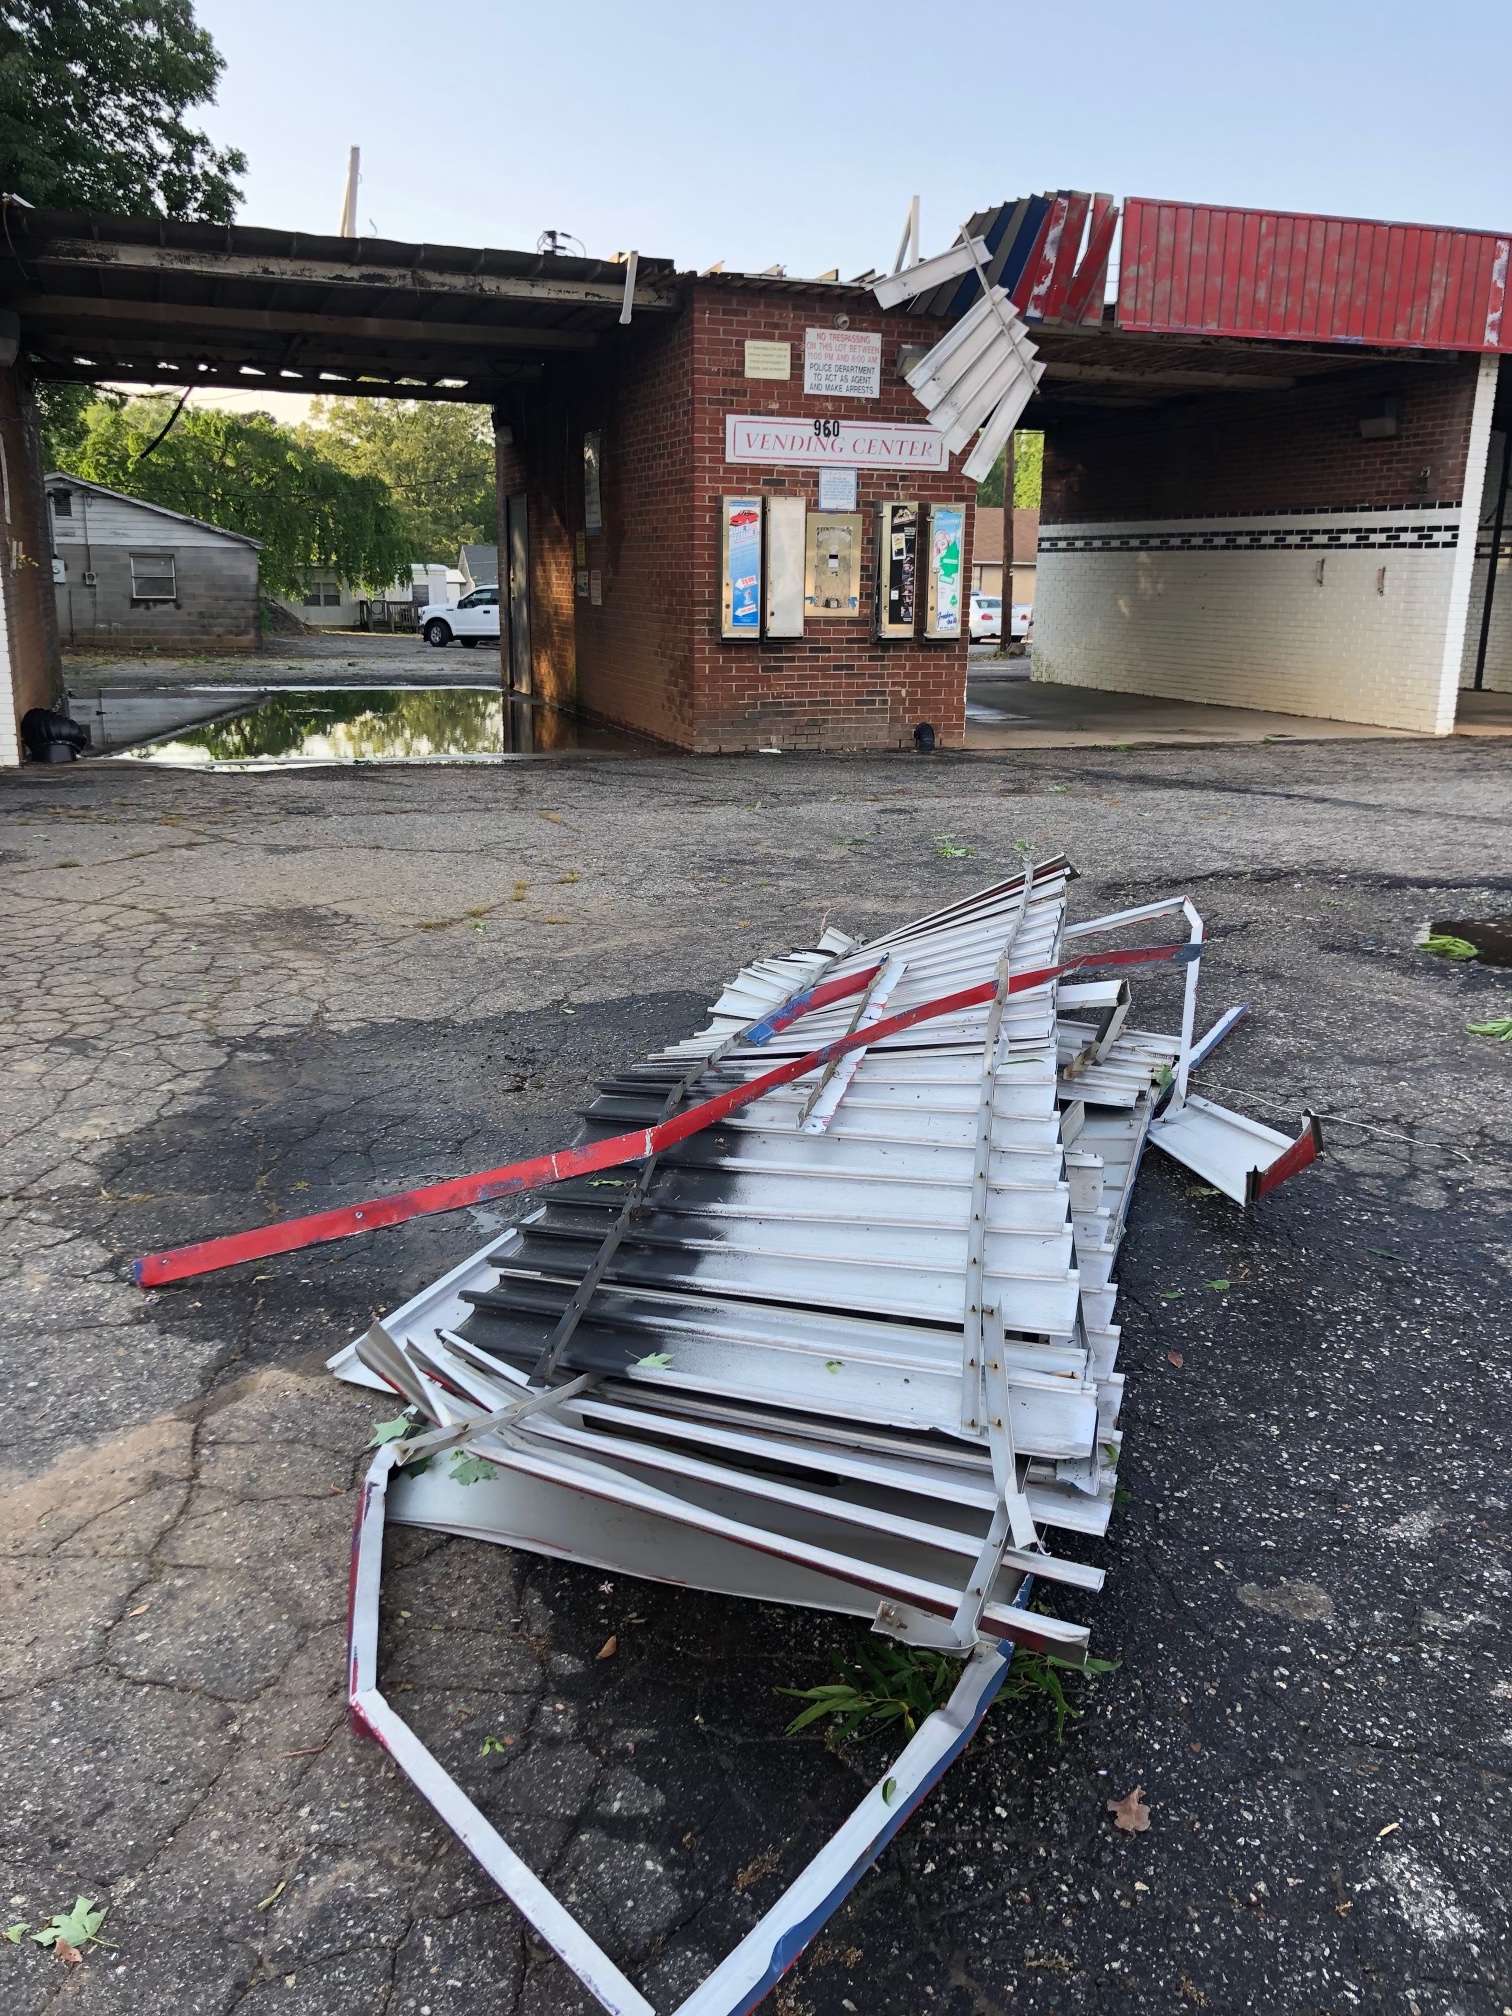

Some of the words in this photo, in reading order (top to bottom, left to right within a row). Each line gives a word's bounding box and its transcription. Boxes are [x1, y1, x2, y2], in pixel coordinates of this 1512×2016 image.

[816, 332, 826, 341] NO
[829, 333, 871, 344] TRESPASSING
[806, 342, 816, 350] ON
[819, 342, 833, 351] THIS
[835, 344, 847, 352] LOT
[849, 345, 880, 354] BETWEEN
[825, 353, 834, 361] PM
[836, 354, 849, 362] AND
[809, 363, 833, 372] POLICE
[835, 365, 876, 375] DEPARTMENT
[813, 373, 822, 381] TO
[825, 374, 837, 382] ACT
[840, 375, 849, 383] AS
[851, 376, 872, 384] AGENT
[810, 383, 823, 392] AND
[825, 384, 843, 393] MAKE
[813, 419, 840, 438] 960
[745, 432, 845, 454] VENDING
[852, 437, 933, 458] CENTER
